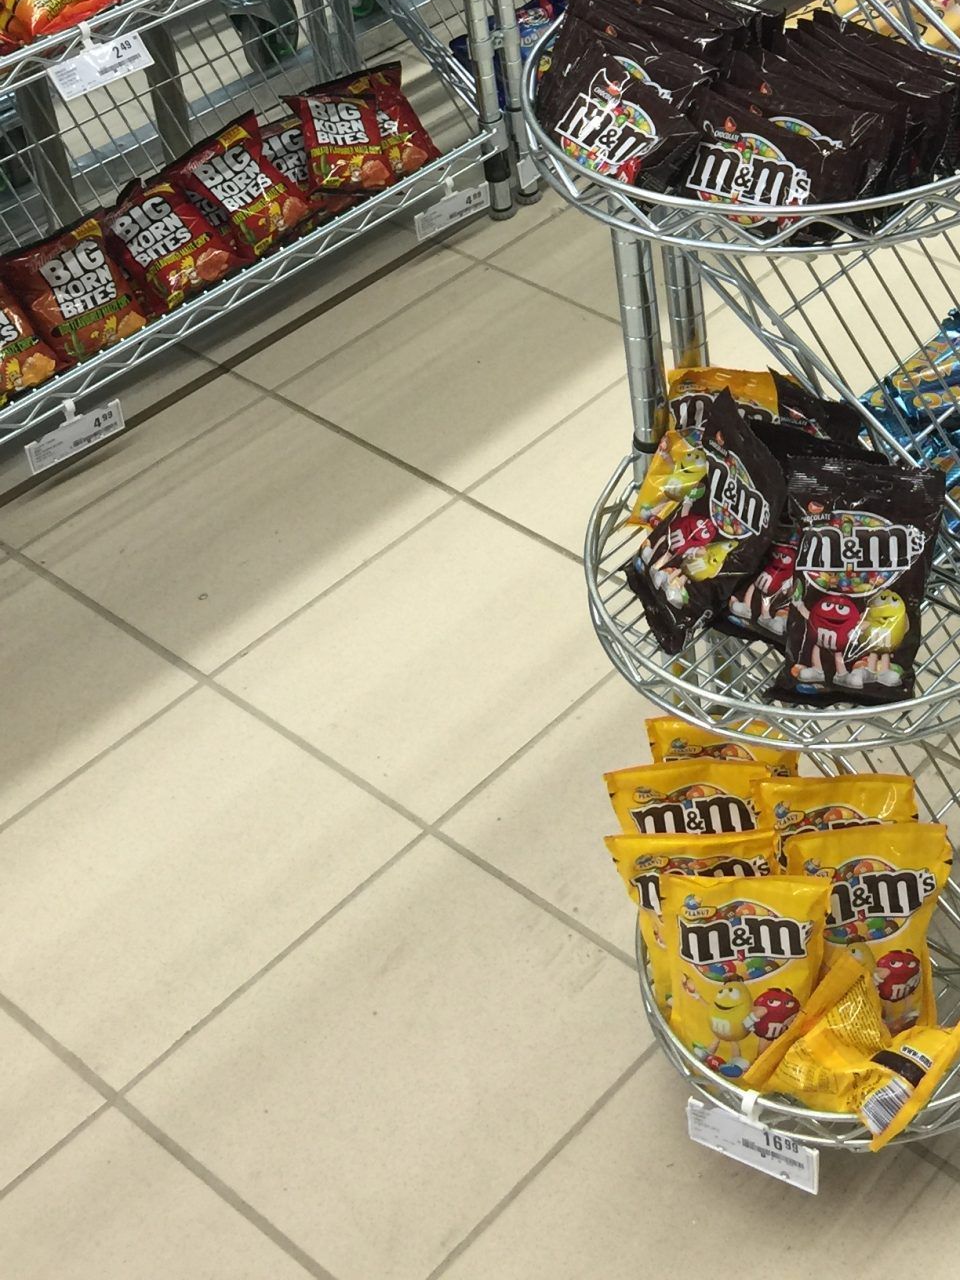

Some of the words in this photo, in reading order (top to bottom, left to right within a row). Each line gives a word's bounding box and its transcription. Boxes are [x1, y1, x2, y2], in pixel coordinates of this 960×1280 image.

[307, 98, 362, 122] BIG
[313, 118, 364, 137] KORN
[316, 129, 370, 147] BITES
[193, 144, 252, 192] BIG
[210, 159, 262, 203] KORN
[685, 142, 812, 207] m&m's
[220, 173, 273, 214] BITES
[114, 194, 173, 242] BIG
[126, 214, 184, 256] KORN
[39, 238, 105, 289] BIG
[134, 228, 193, 269] BITES
[51, 263, 115, 305] KORN
[59, 281, 118, 320] BITES
[795, 524, 928, 570] m&m's
[683, 906, 712, 918] PEANUT
